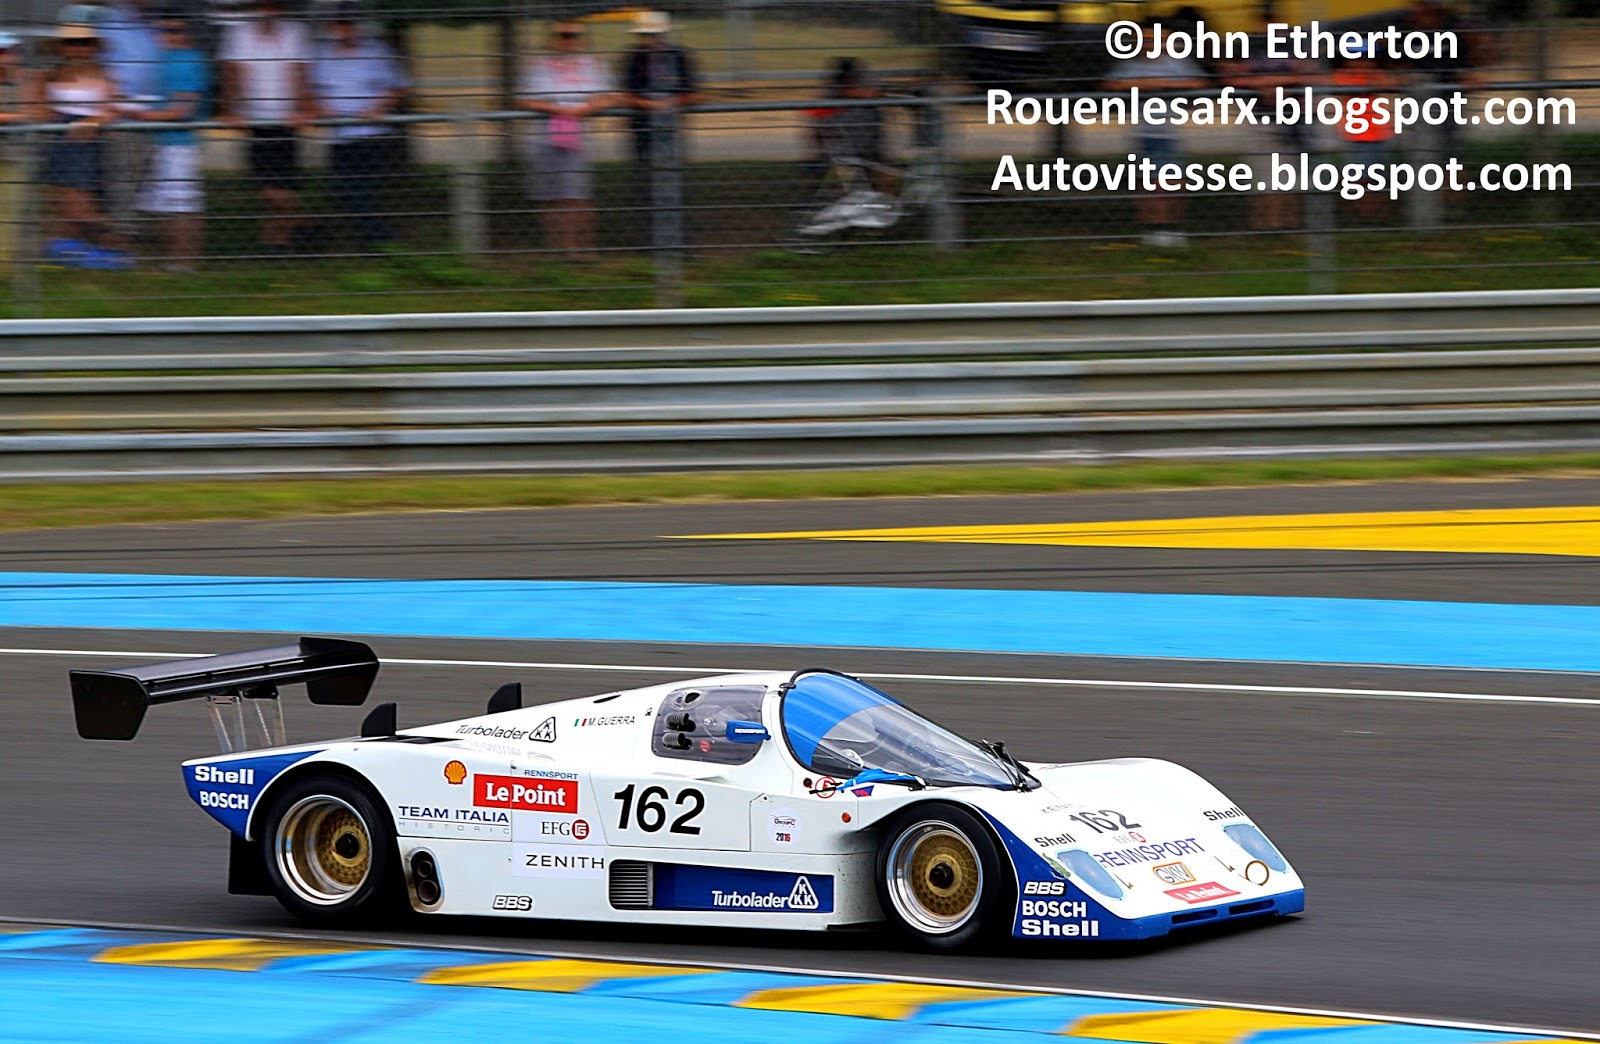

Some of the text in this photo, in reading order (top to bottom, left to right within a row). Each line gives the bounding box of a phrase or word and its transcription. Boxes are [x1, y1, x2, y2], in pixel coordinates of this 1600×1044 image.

[455, 724, 529, 740] Turbolader
[194, 765, 254, 785] Shell
[524, 769, 579, 780] RENNSPORT
[199, 790, 249, 810] BOSCH
[398, 805, 510, 824] TEAM ITALIA
[613, 783, 705, 836] 162
[1202, 806, 1245, 821] Shell
[540, 821, 571, 836] EFG
[1068, 809, 1142, 834] 162
[1033, 832, 1077, 848] Shell
[525, 854, 605, 870] ZENITH
[1093, 837, 1205, 869] RENNSPORT
[1024, 881, 1067, 896] BBS
[492, 895, 533, 911] BBS
[711, 890, 789, 908] Turbolader
[1021, 900, 1088, 918] BOSCH
[1021, 918, 1099, 937] Shell
